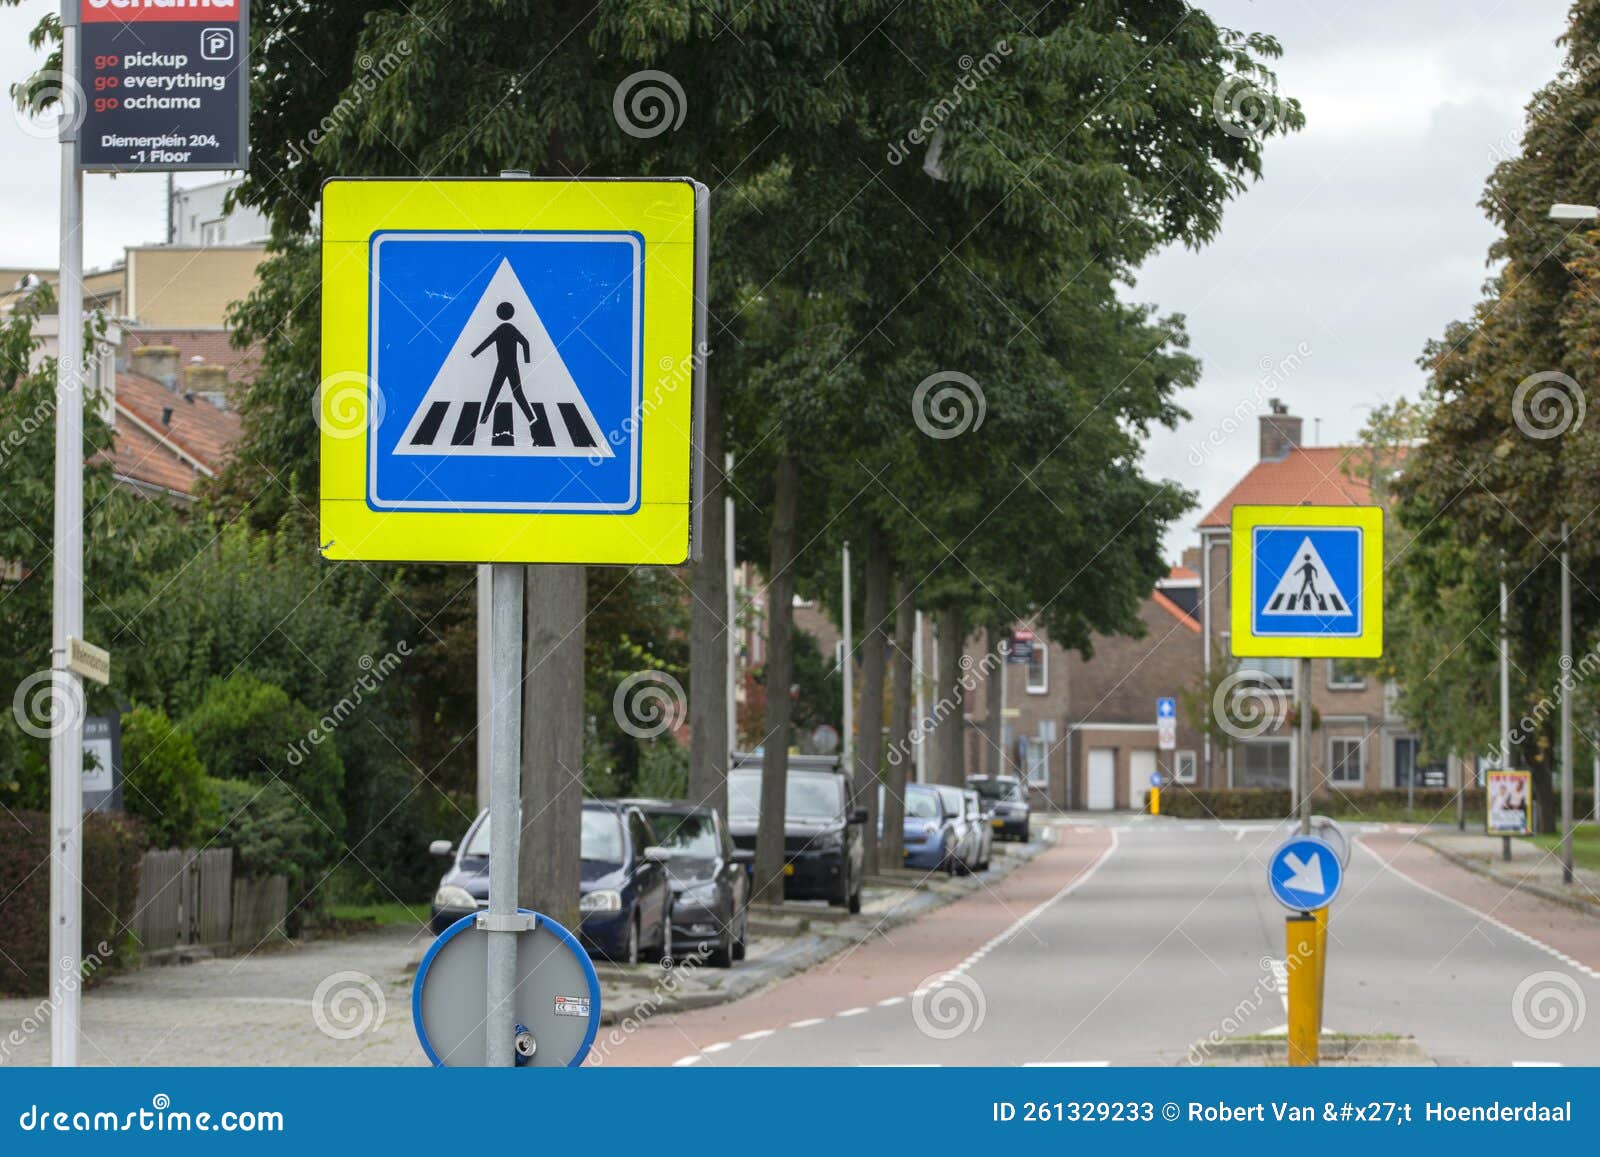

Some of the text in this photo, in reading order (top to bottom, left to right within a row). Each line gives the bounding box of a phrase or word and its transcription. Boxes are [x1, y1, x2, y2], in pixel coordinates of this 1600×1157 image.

[94, 51, 188, 70] go pickup
[94, 72, 226, 91] go everything
[94, 94, 201, 112] go ochama
[101, 134, 220, 149] Diemerplein 204,
[130, 150, 191, 163] -1 Floor
